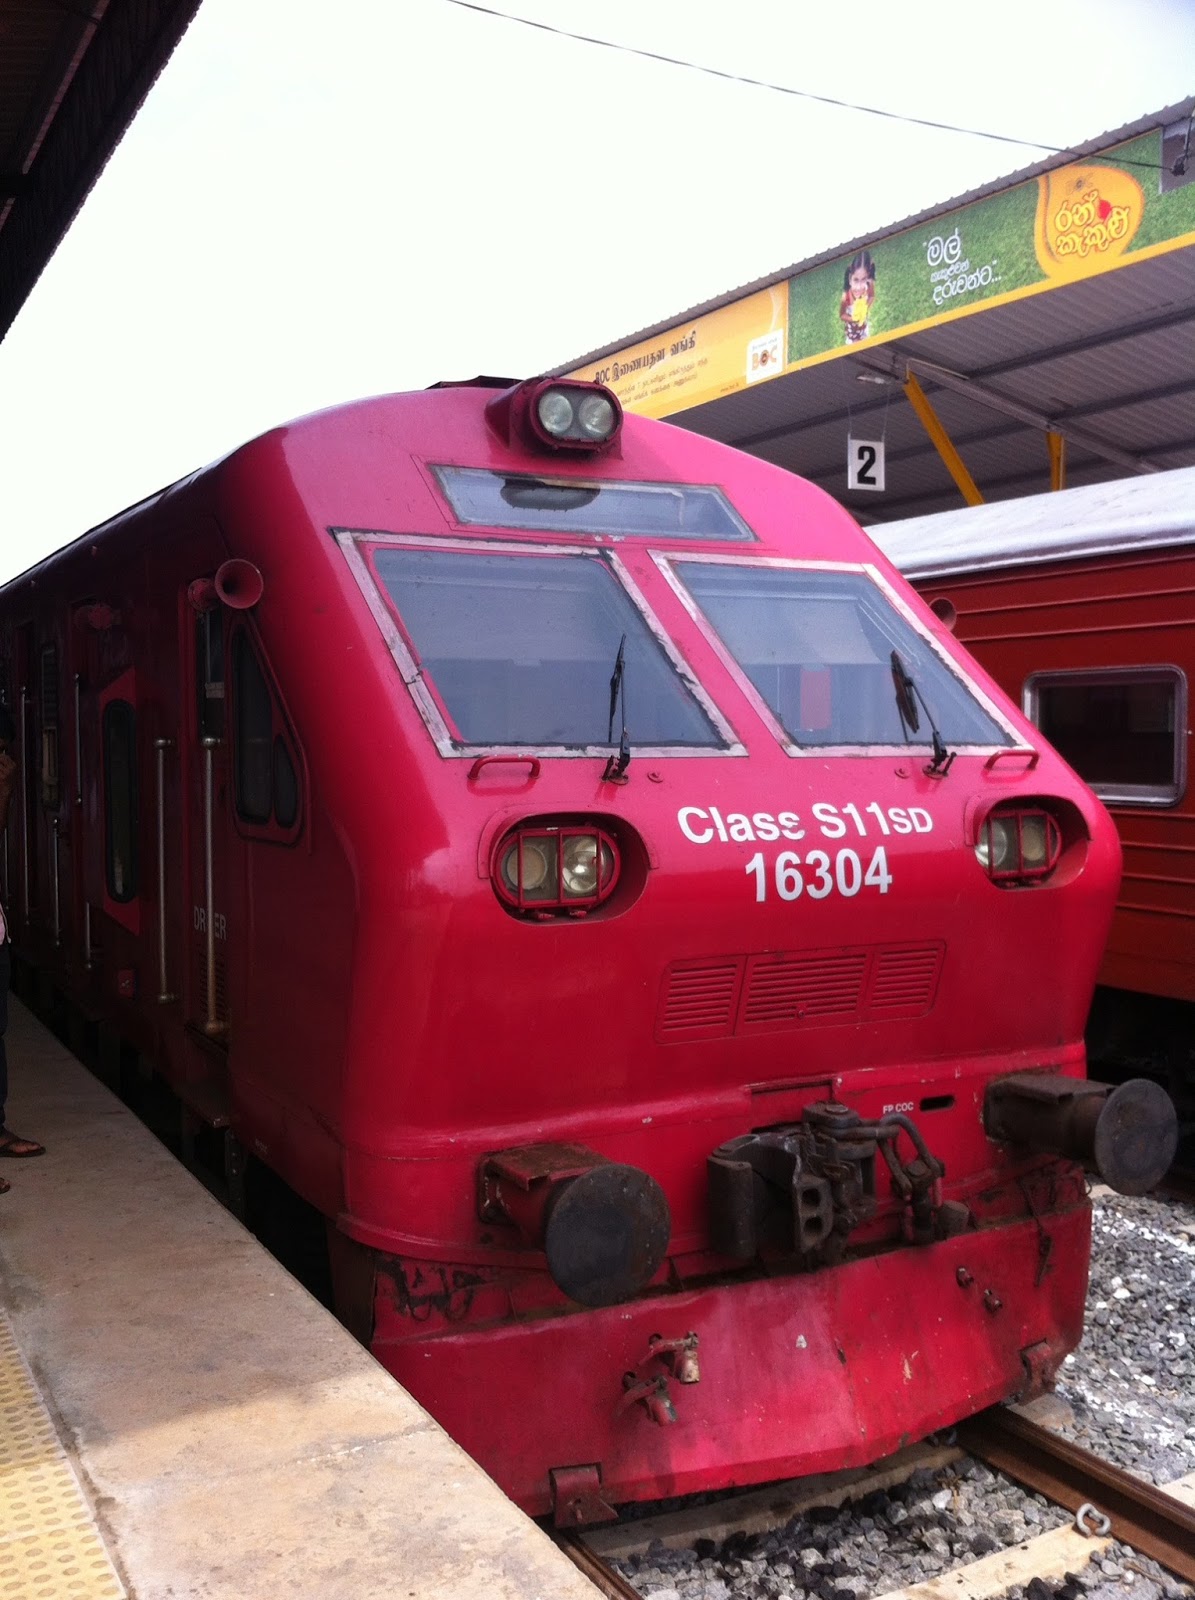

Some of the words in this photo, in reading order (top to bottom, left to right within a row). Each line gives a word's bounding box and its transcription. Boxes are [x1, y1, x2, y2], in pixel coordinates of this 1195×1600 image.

[1054, 189, 1099, 232] රන්
[927, 227, 961, 266] මල්
[857, 445, 876, 486] 2
[677, 805, 806, 844] Class
[745, 846, 893, 903] 16304
[193, 905, 227, 941] DRER
